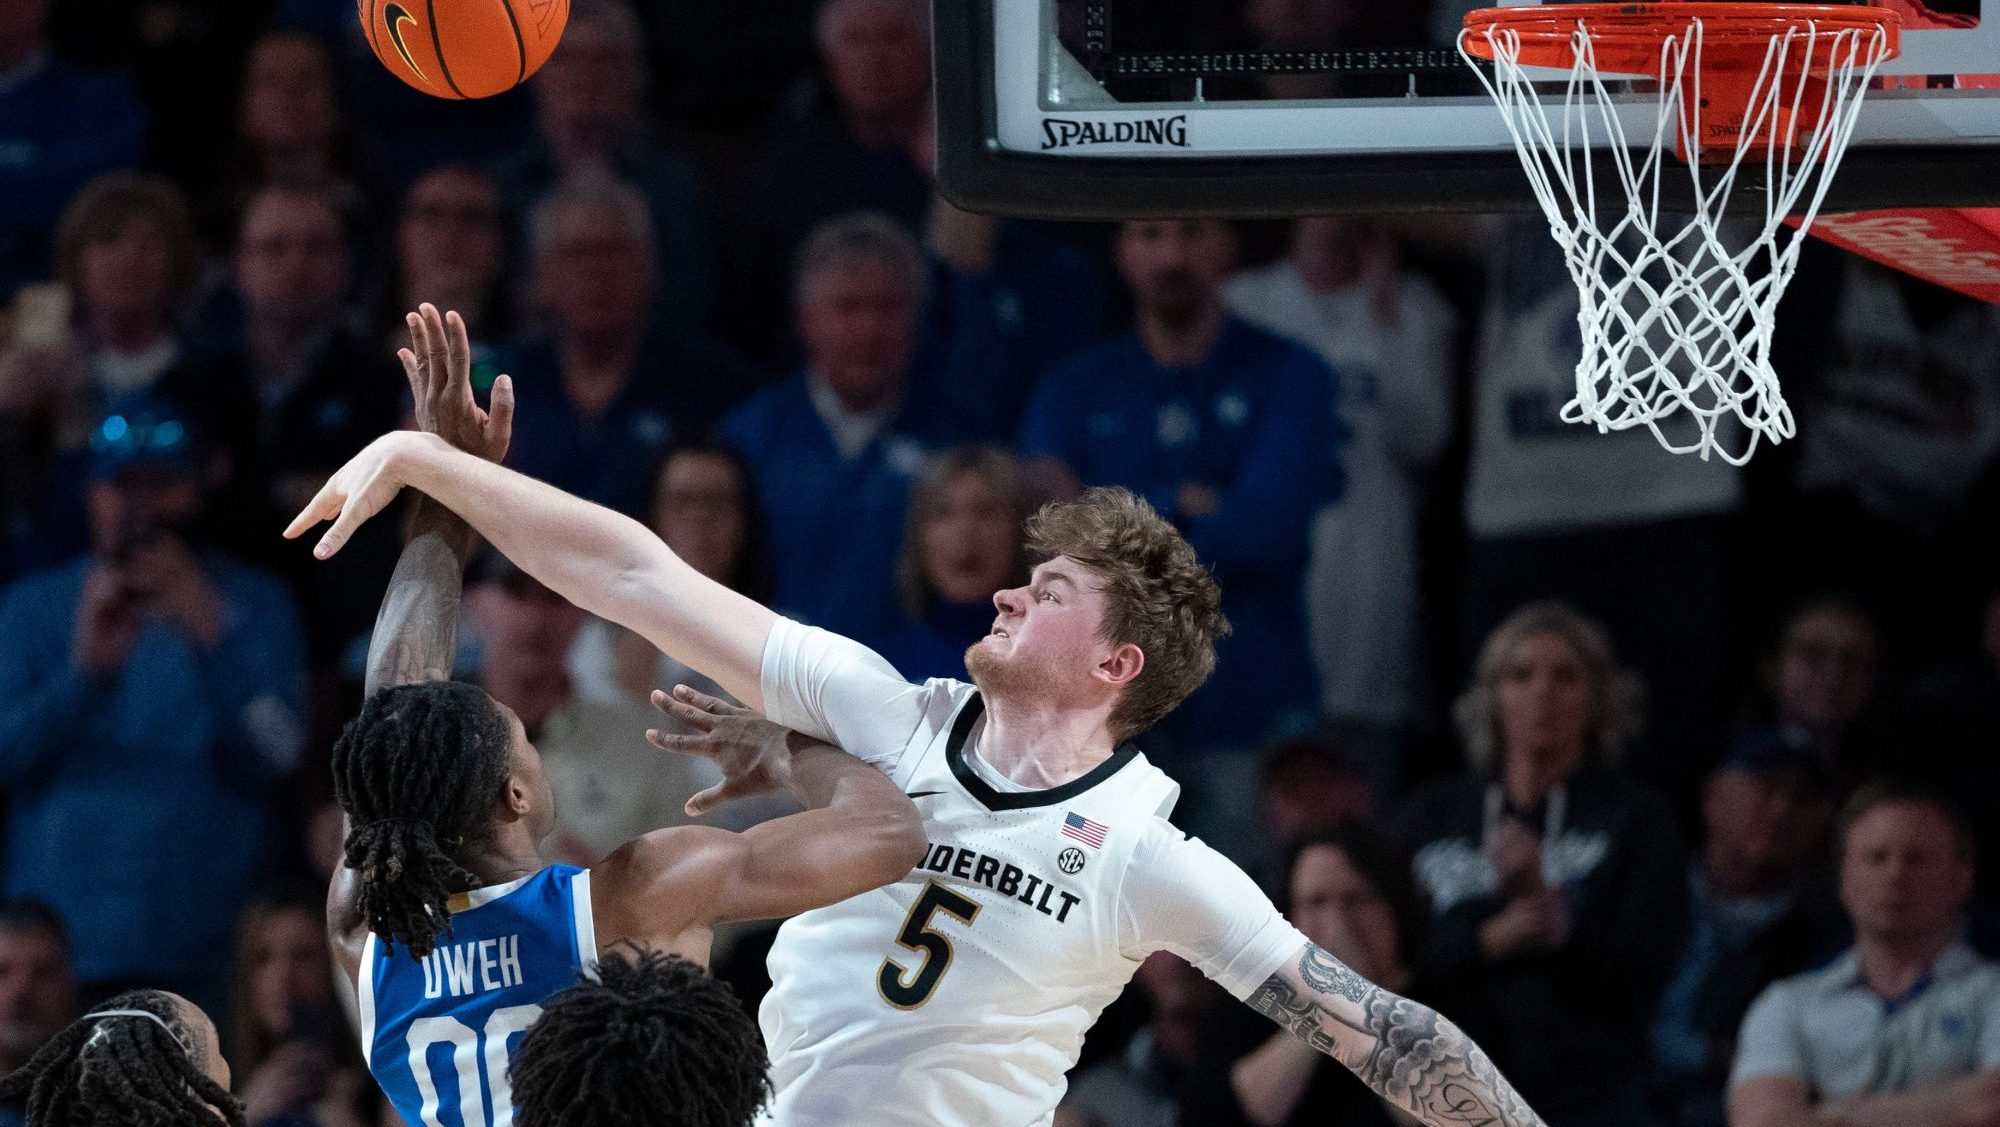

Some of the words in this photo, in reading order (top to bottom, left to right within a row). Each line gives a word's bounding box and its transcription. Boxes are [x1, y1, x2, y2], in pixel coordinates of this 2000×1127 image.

[1041, 114, 1187, 149] SPALDING
[1711, 124, 1766, 137] SPALIG
[1059, 848, 1084, 873] SEC
[876, 878, 983, 1011] 5
